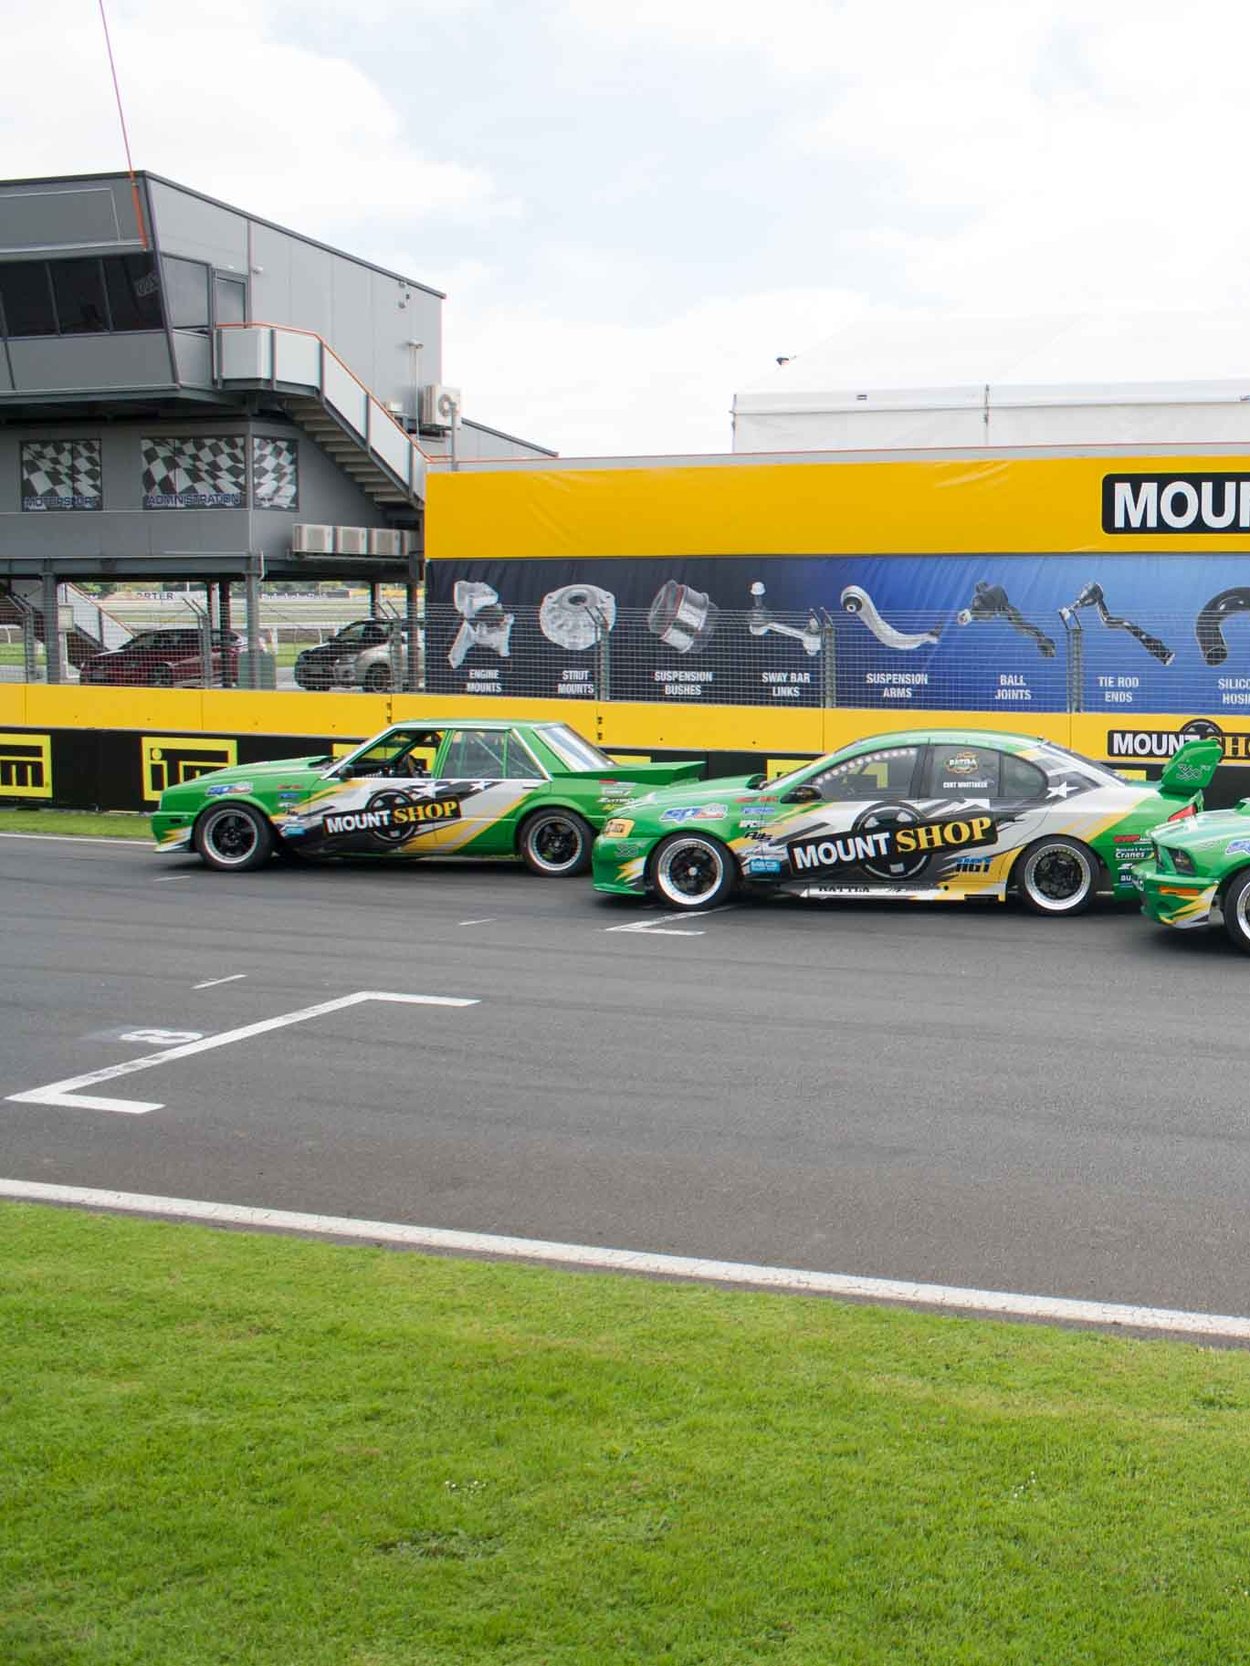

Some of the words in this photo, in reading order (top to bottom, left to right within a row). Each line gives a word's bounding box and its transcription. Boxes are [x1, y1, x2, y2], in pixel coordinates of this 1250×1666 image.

[469, 669, 499, 679] ENGINE
[562, 670, 589, 680] STRUT
[654, 671, 713, 682] SUSPENSION
[761, 672, 787, 683] SWAY
[790, 672, 811, 683] BAR
[866, 673, 928, 685] SUSPENSION
[1000, 674, 1026, 686] BALL
[1098, 676, 1114, 688] TIE
[1118, 677, 1139, 688] ROD
[466, 682, 502, 693] MOUNTS
[557, 683, 594, 694] MOUNTS
[664, 684, 701, 696] BUSHES
[772, 686, 800, 697] LINKS
[883, 687, 912, 698] ARMS
[995, 689, 1032, 700] JOINTS
[1104, 691, 1133, 703] ENDS
[1113, 733, 1200, 755] MOUN
[325, 810, 391, 833] MOUNT
[393, 801, 457, 824] SHOP
[793, 832, 890, 869] MOUNT
[895, 816, 991, 852] SHOP
